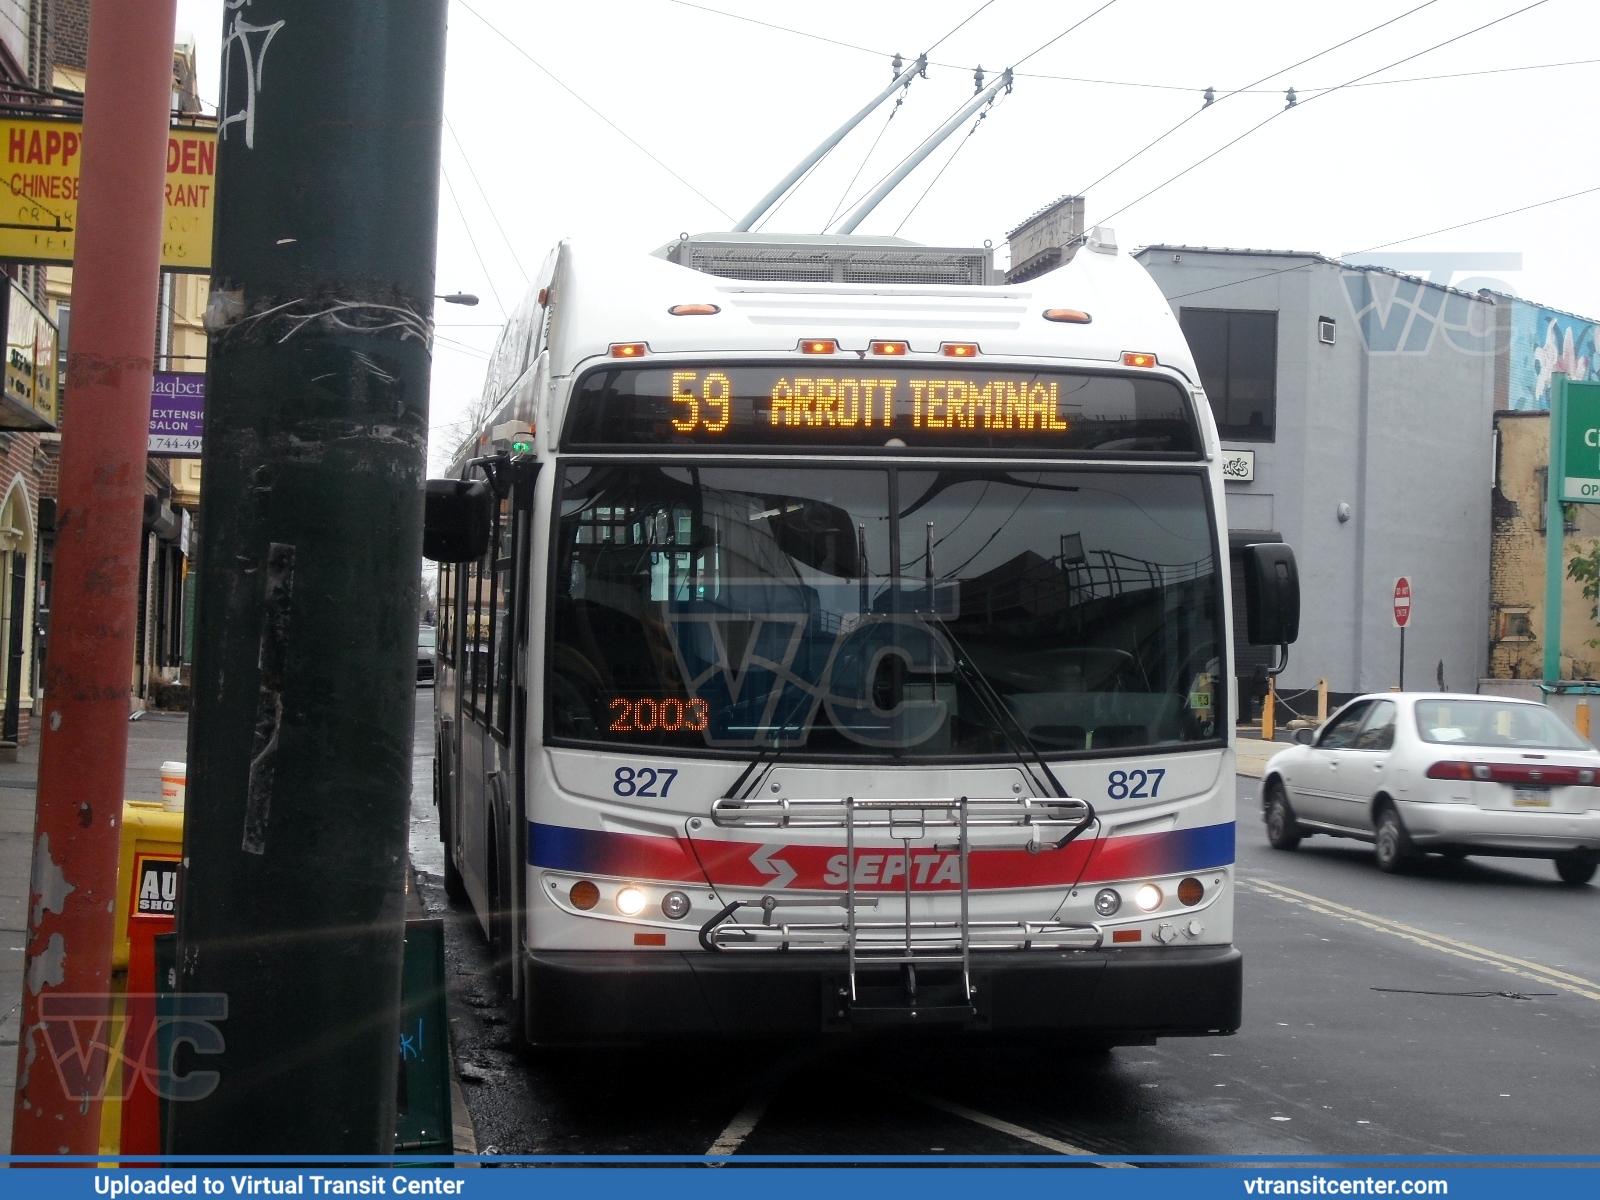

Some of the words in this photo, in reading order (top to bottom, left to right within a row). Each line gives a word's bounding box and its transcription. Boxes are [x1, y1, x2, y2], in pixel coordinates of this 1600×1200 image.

[9, 127, 82, 167] HAPP
[166, 138, 215, 176] DEN
[165, 183, 210, 209] RANT
[152, 376, 204, 399] laqber
[672, 372, 730, 431] 59
[771, 377, 897, 427] ARROTT
[909, 379, 1067, 430] TERMINAL
[149, 421, 188, 431] SALON
[157, 438, 202, 449] 744-49
[1581, 484, 1600, 496] OP
[609, 698, 708, 731] 2003
[613, 766, 679, 798] 827
[1107, 768, 1166, 800] 827
[823, 854, 968, 885] SEPTA
[140, 870, 177, 900] AU
[139, 900, 176, 911] SHO
